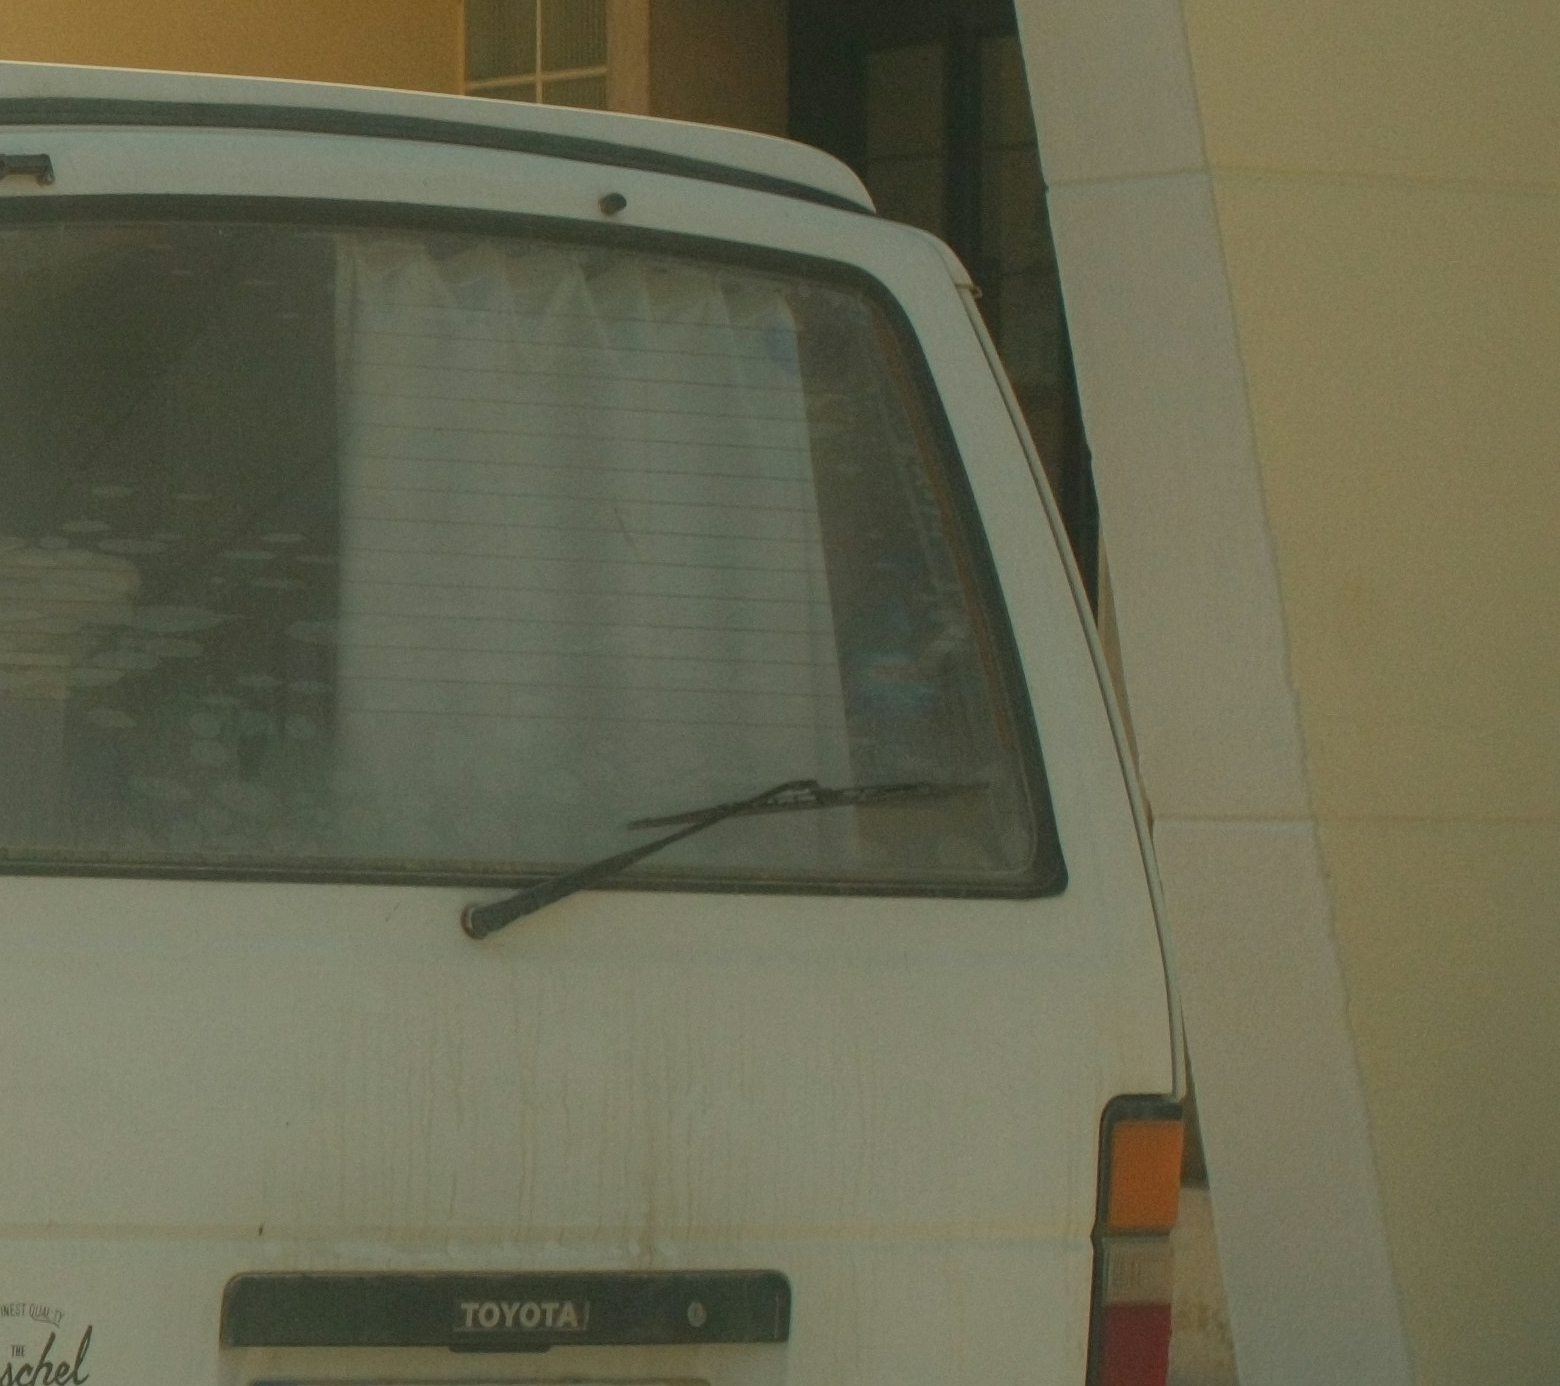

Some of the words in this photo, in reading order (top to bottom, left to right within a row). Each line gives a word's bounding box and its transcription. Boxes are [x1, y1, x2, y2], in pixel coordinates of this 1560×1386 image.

[28, 1302, 66, 1326] QUALTY
[461, 1300, 579, 1328] TOYOTA
[10, 1344, 26, 1358] THE
